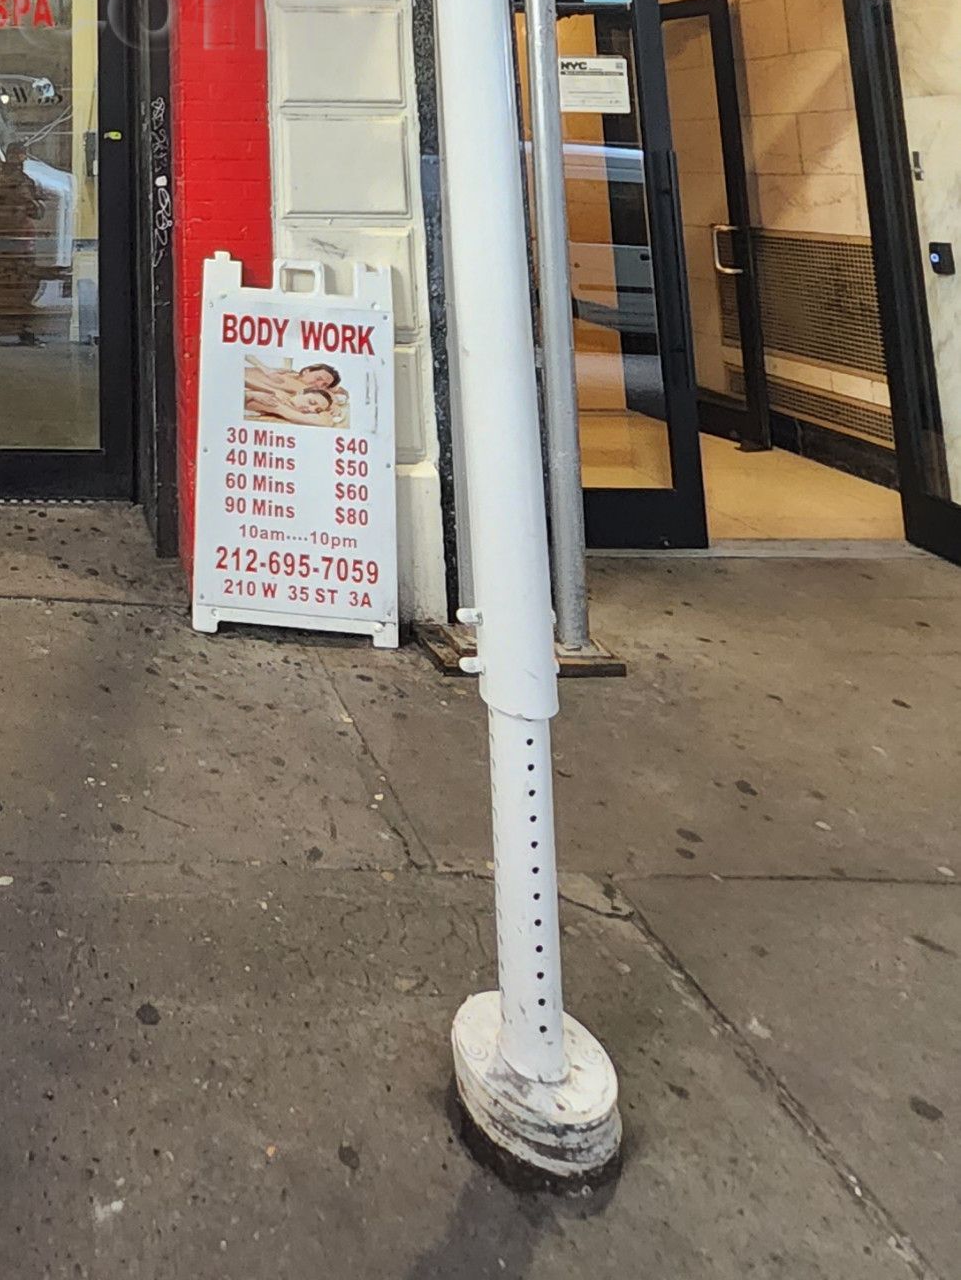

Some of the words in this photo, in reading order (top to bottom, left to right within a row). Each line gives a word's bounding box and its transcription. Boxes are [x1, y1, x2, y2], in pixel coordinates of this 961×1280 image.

[560, 61, 588, 70] NYC
[222, 314, 290, 347] BODY
[301, 320, 375, 355] WORK
[227, 427, 248, 444] 30
[254, 429, 296, 448] Mins
[335, 437, 368, 455] $40
[226, 449, 247, 466] 40
[253, 451, 296, 470] Mins
[335, 458, 368, 477] $50
[225, 473, 247, 490] 60
[252, 475, 295, 494] Mins
[335, 482, 368, 501] $60
[225, 496, 246, 513] 90
[252, 499, 295, 518] Mins
[335, 506, 368, 525] $80
[215, 546, 379, 584] 212-695-7059
[224, 579, 256, 596] 210
[262, 582, 277, 598] W
[288, 585, 309, 602] 35
[315, 588, 338, 604] ST
[349, 592, 372, 608] 3A
